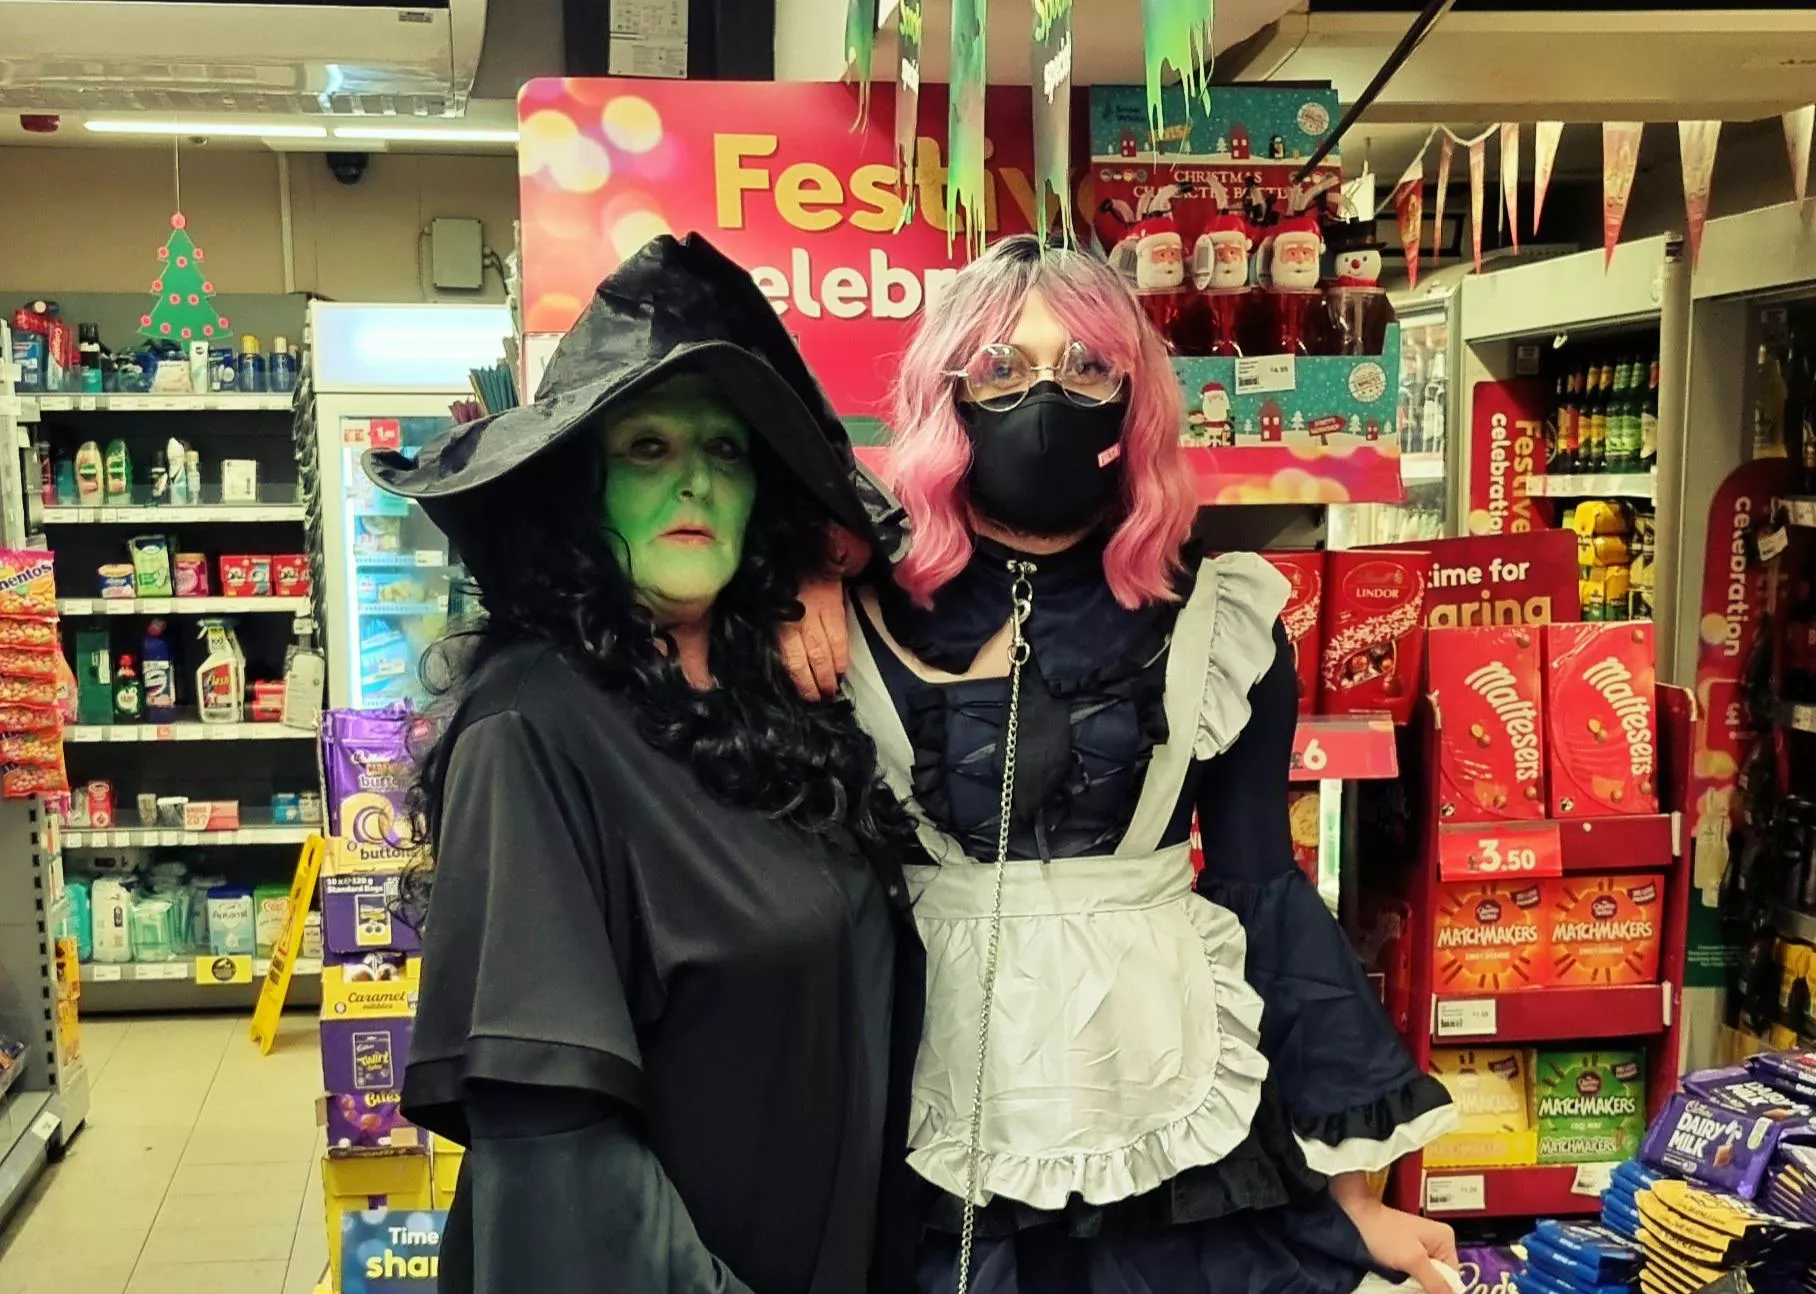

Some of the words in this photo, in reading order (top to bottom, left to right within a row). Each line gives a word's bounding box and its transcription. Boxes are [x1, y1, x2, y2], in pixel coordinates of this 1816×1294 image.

[714, 133, 1092, 231] Festiv
[1489, 558, 1530, 582] for
[1356, 587, 1399, 598] LINDOR
[1468, 839, 1537, 872] £3.50
[1437, 925, 1538, 947] MATCHMAKERS
[1552, 920, 1653, 942] MATCHMAKERS
[348, 991, 406, 1003] Caramel
[1539, 1097, 1636, 1116] MATCHMAKERS
[1677, 1112, 1726, 1141] DAIRY
[1540, 1135, 1618, 1153] MATCHMAKERS
[1668, 1130, 1709, 1157] MILK
[388, 1226, 439, 1245] Time
